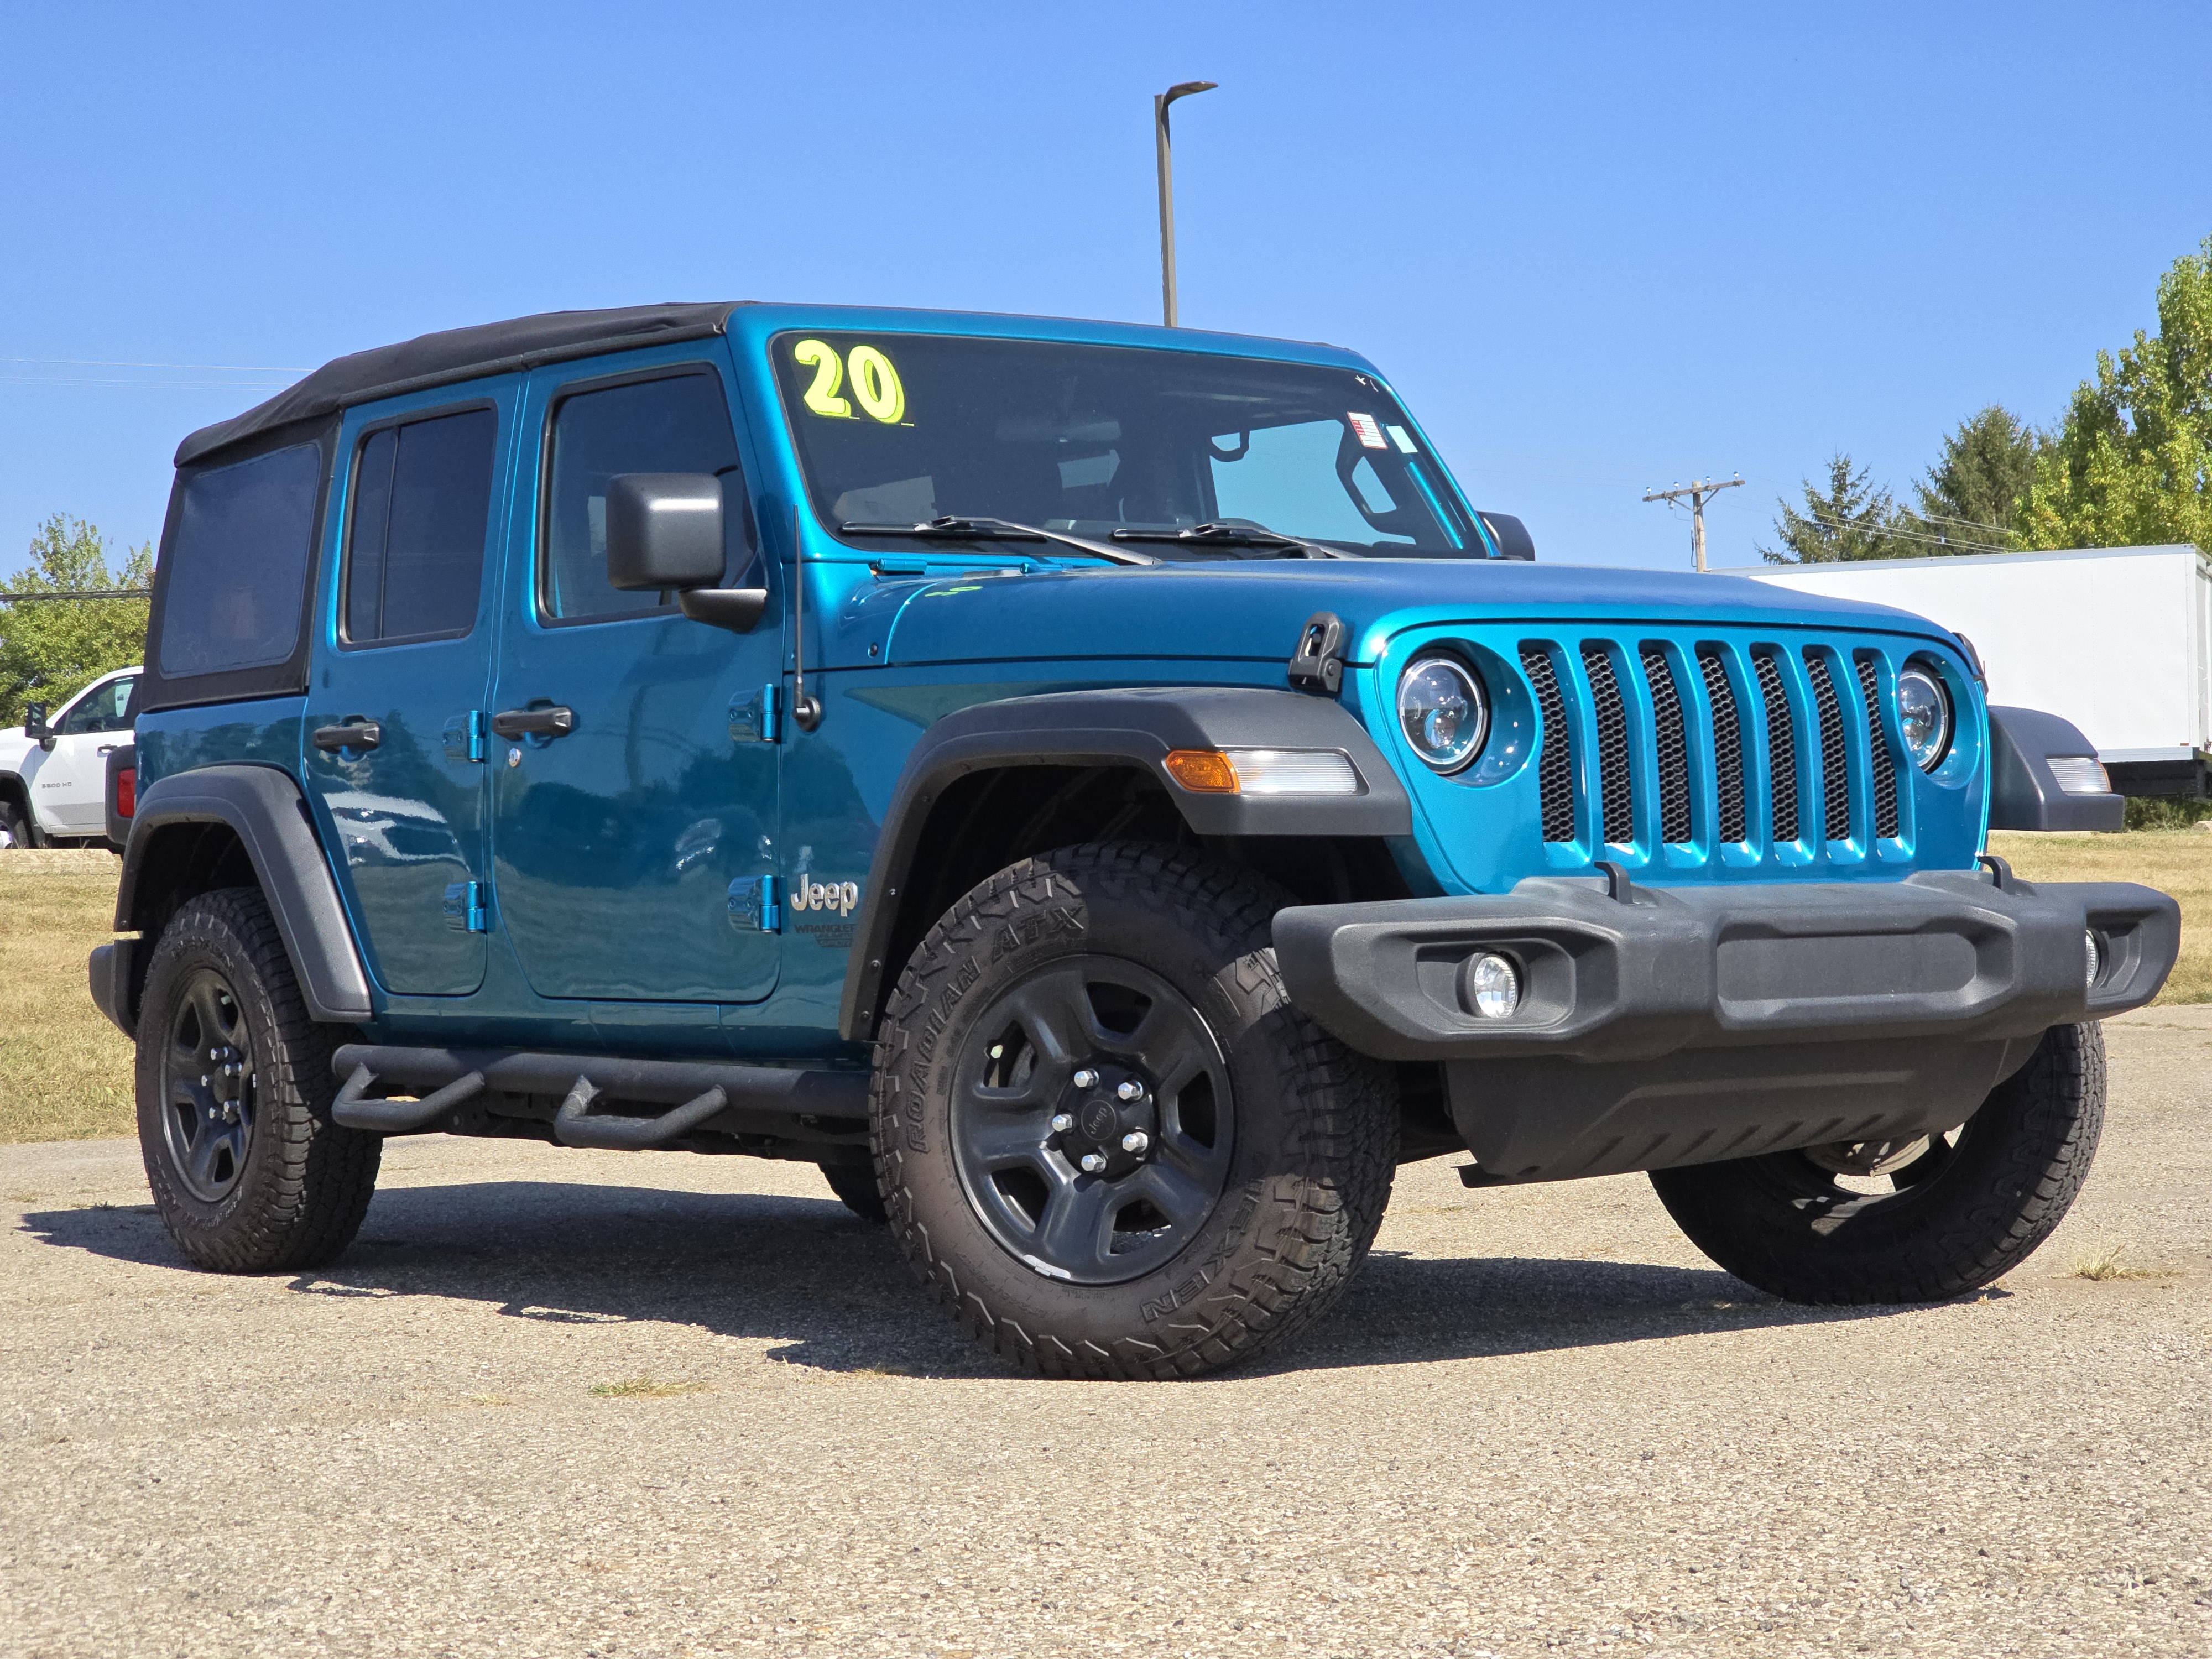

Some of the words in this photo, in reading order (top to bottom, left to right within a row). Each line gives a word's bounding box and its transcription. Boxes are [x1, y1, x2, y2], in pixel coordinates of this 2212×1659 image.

[795, 340, 905, 424] 20
[790, 873, 858, 917] Jeep
[1089, 1107, 1107, 1134] Jeep
[1140, 1178, 1266, 1323] NEXEN
